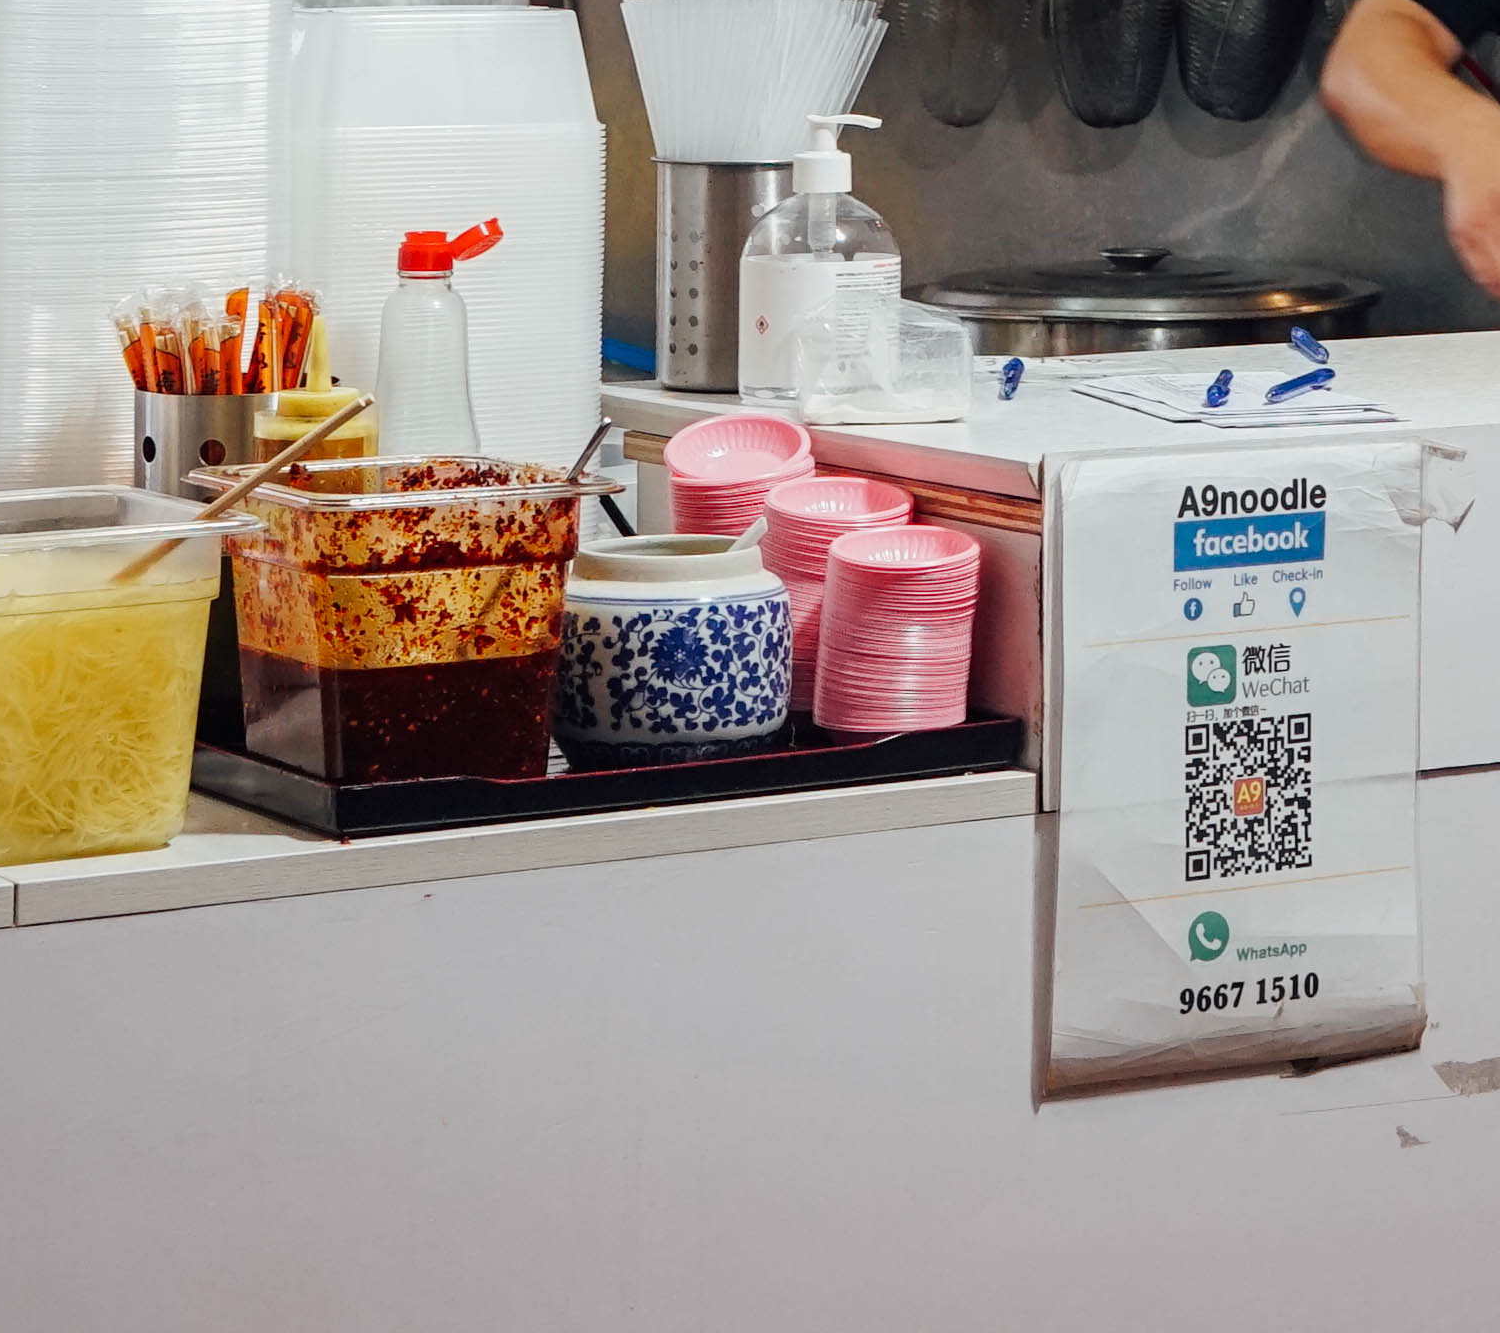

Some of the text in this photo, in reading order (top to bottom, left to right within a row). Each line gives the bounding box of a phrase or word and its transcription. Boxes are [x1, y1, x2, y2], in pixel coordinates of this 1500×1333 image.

[1176, 479, 1328, 519] A9noodle
[1192, 527, 1309, 557] facebook
[1173, 568, 1324, 592] Follow Like Check-in
[1242, 643, 1291, 675] 微信
[1242, 677, 1310, 698] WeChat
[1237, 780, 1261, 803] A9
[1236, 941, 1307, 961] WhatsApp
[1179, 972, 1319, 1015] 9667 1510
